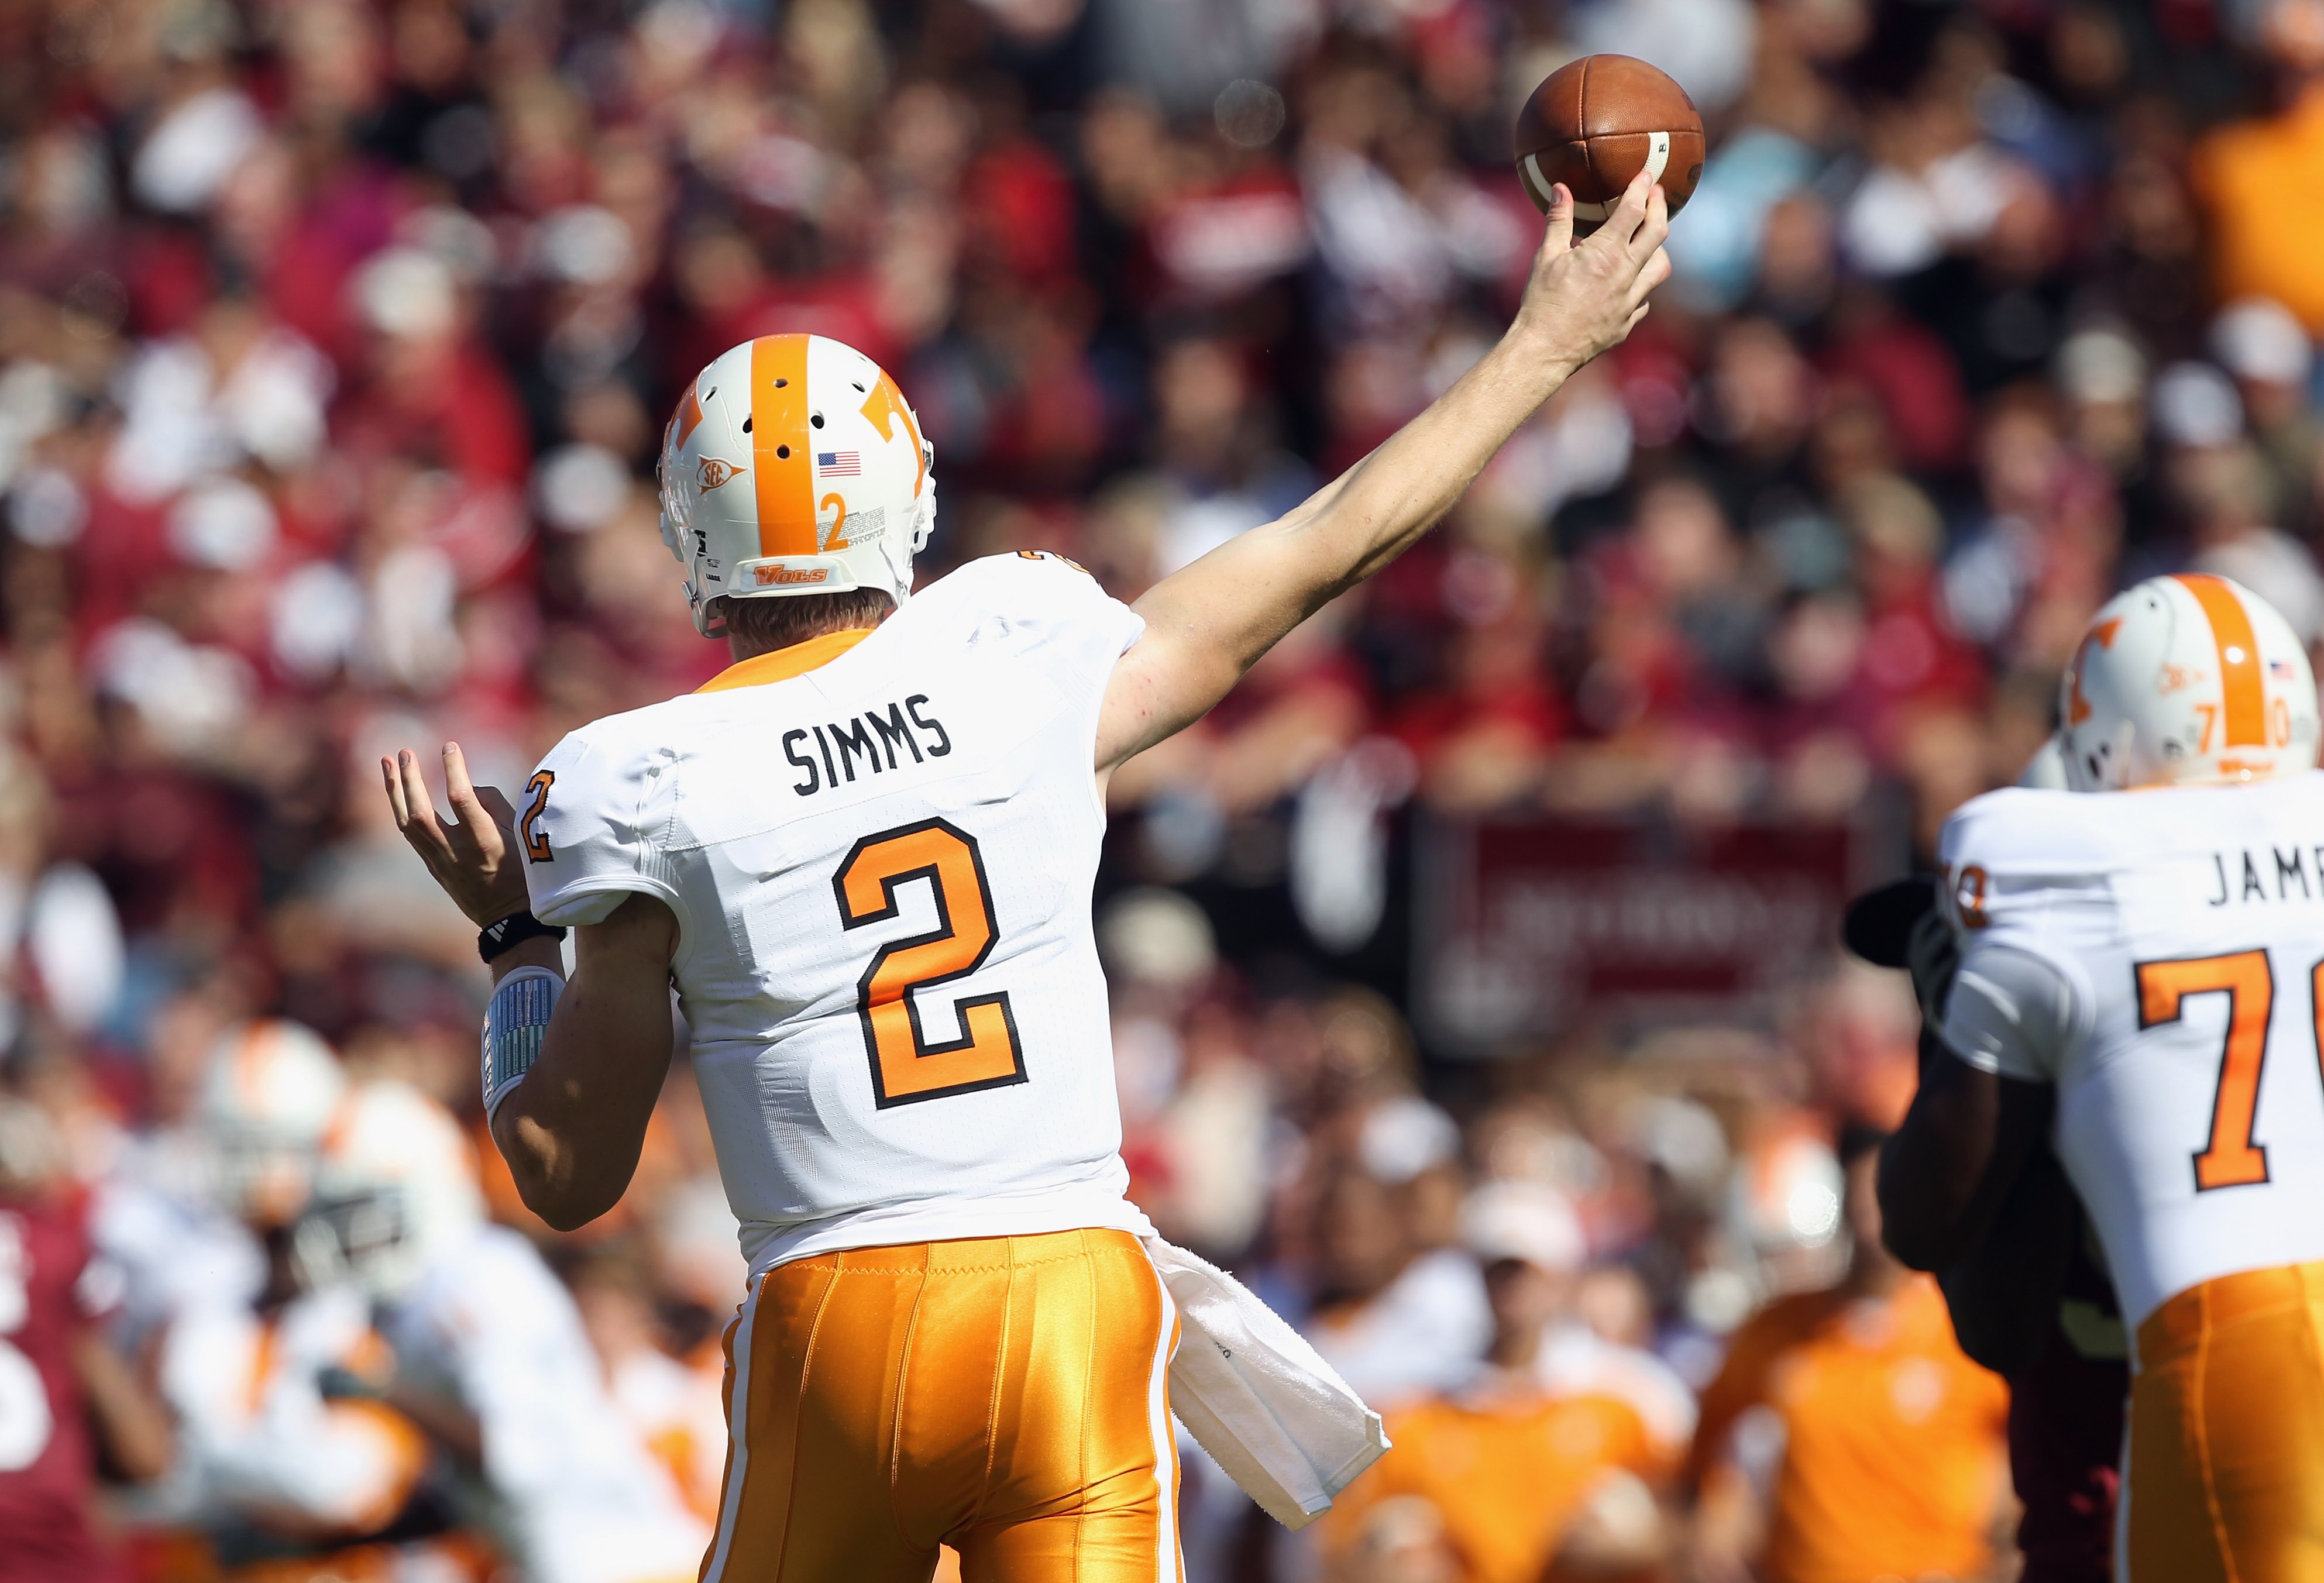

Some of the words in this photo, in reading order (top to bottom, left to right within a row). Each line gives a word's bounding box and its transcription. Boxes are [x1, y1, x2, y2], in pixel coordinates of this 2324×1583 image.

[704, 462, 726, 486] SEC
[820, 493, 848, 552] 2
[782, 693, 951, 796] SIMMS
[520, 769, 555, 864] 2
[831, 816, 1029, 1110] 2
